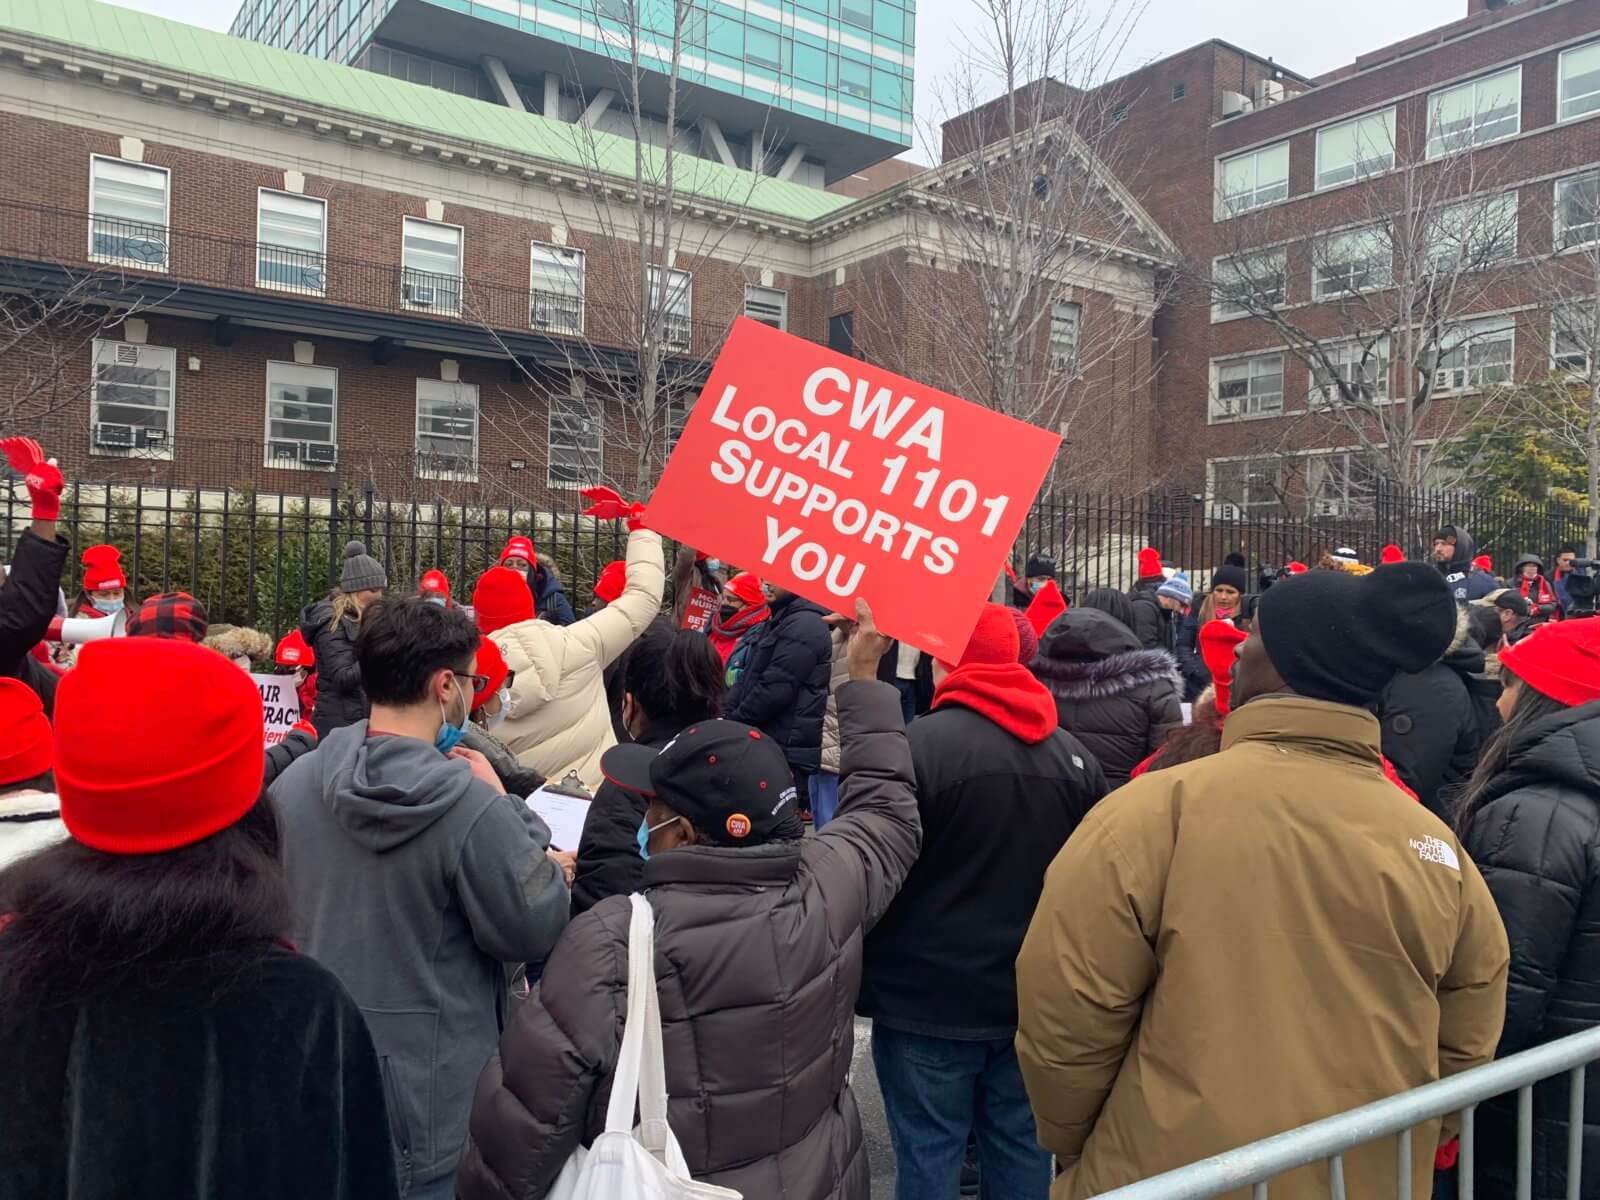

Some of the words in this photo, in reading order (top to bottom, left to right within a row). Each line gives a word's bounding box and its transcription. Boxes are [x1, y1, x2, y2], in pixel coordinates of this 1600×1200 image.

[803, 367, 945, 462] CWA
[711, 385, 854, 479] LOCAL
[881, 455, 1009, 537] 1101
[711, 439, 959, 575] SUPPORTS
[762, 516, 866, 597] YOU
[1408, 838, 1444, 854] NORTH
[1419, 850, 1445, 863] FACE
[1423, 833, 1443, 846] THE
